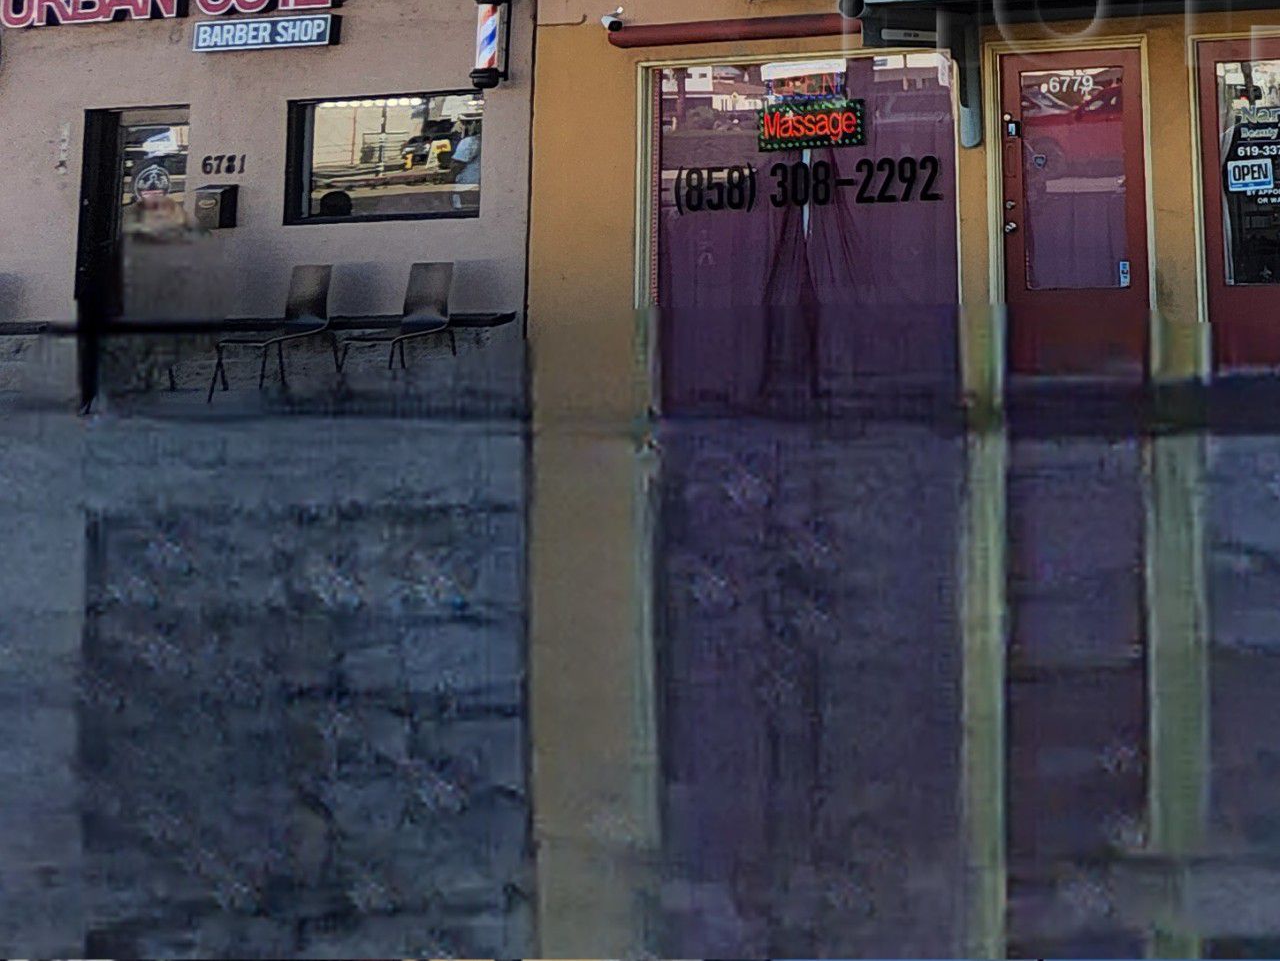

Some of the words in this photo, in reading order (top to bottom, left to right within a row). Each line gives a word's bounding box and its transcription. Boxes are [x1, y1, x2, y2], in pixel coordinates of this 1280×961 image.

[197, 21, 271, 47] BARBER
[275, 19, 325, 42] SHOP
[1049, 75, 1094, 93] 6779
[763, 111, 857, 141] Massage
[674, 163, 757, 216] (858)
[769, 155, 944, 209] 308-2292
[1232, 162, 1269, 182] OPEN
